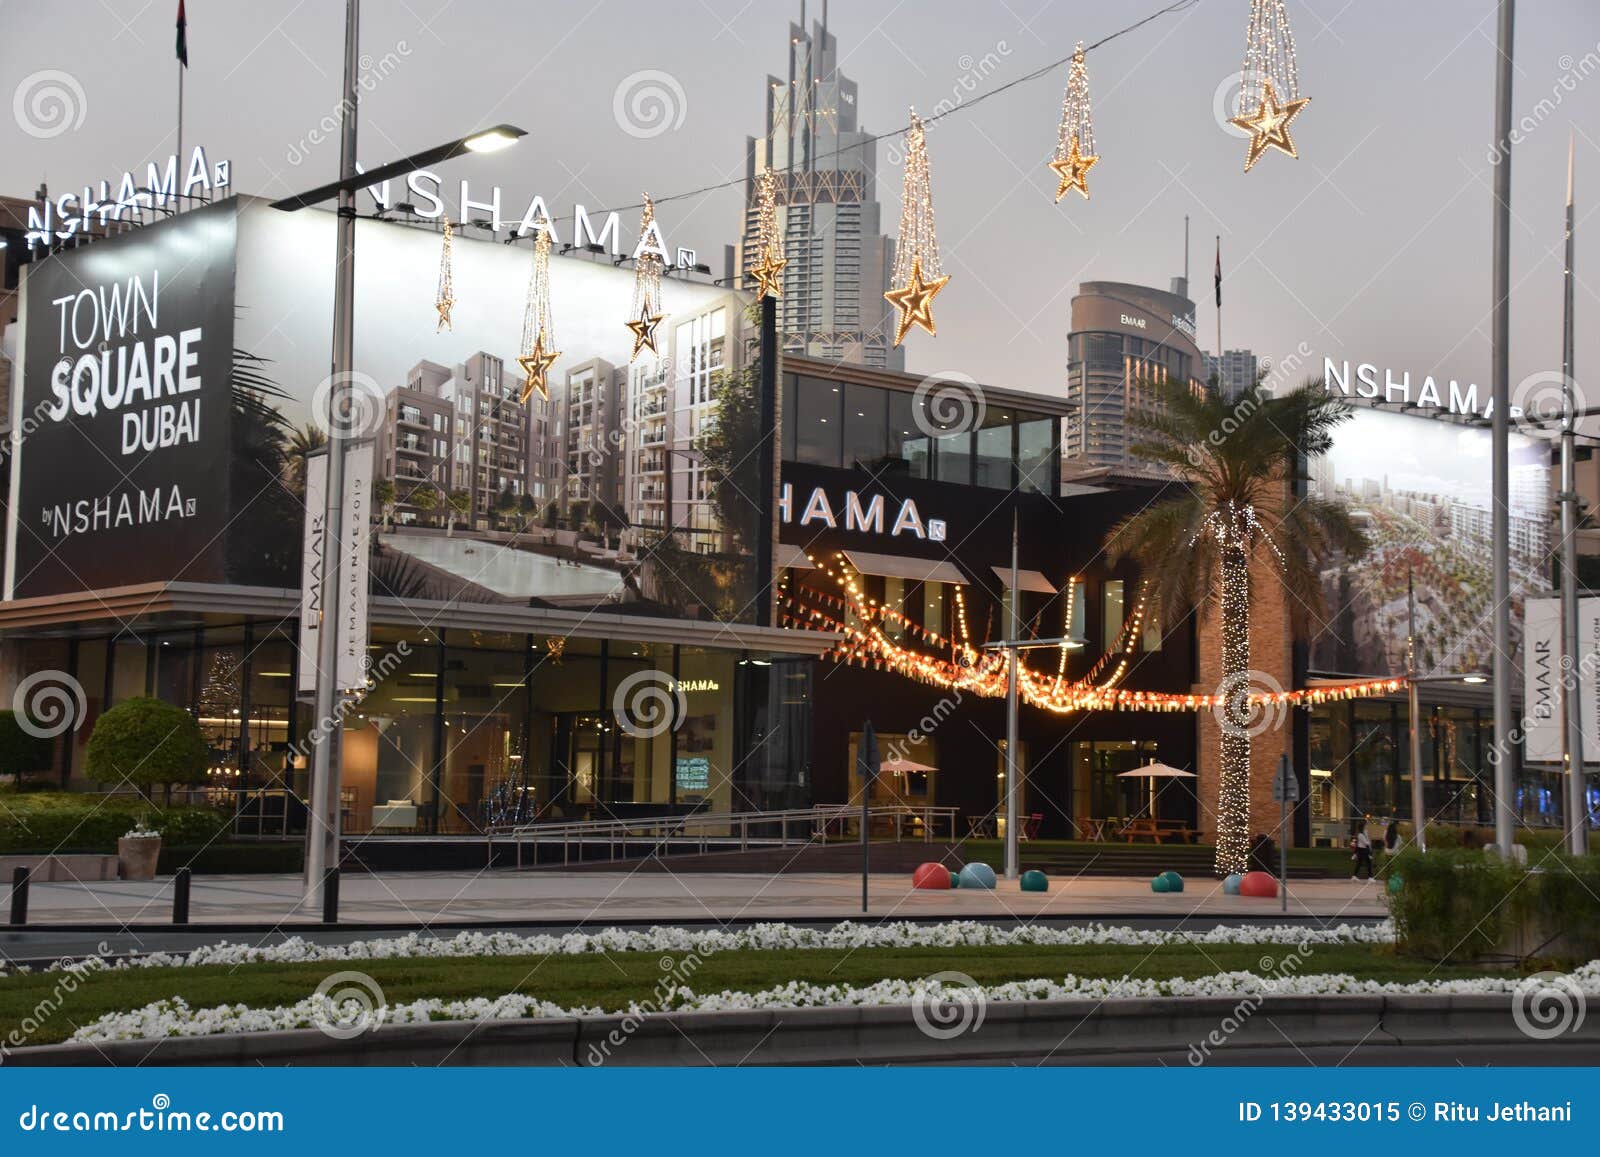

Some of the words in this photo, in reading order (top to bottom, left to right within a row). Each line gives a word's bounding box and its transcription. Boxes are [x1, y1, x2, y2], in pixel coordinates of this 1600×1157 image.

[27, 146, 211, 249] NSHAMA
[52, 269, 159, 354] TOWN
[51, 327, 202, 422] SQUARE
[121, 398, 200, 455] DUBAI
[42, 507, 52, 526] by
[53, 484, 184, 537] NSHAMA
[308, 513, 324, 630] EMAAR
